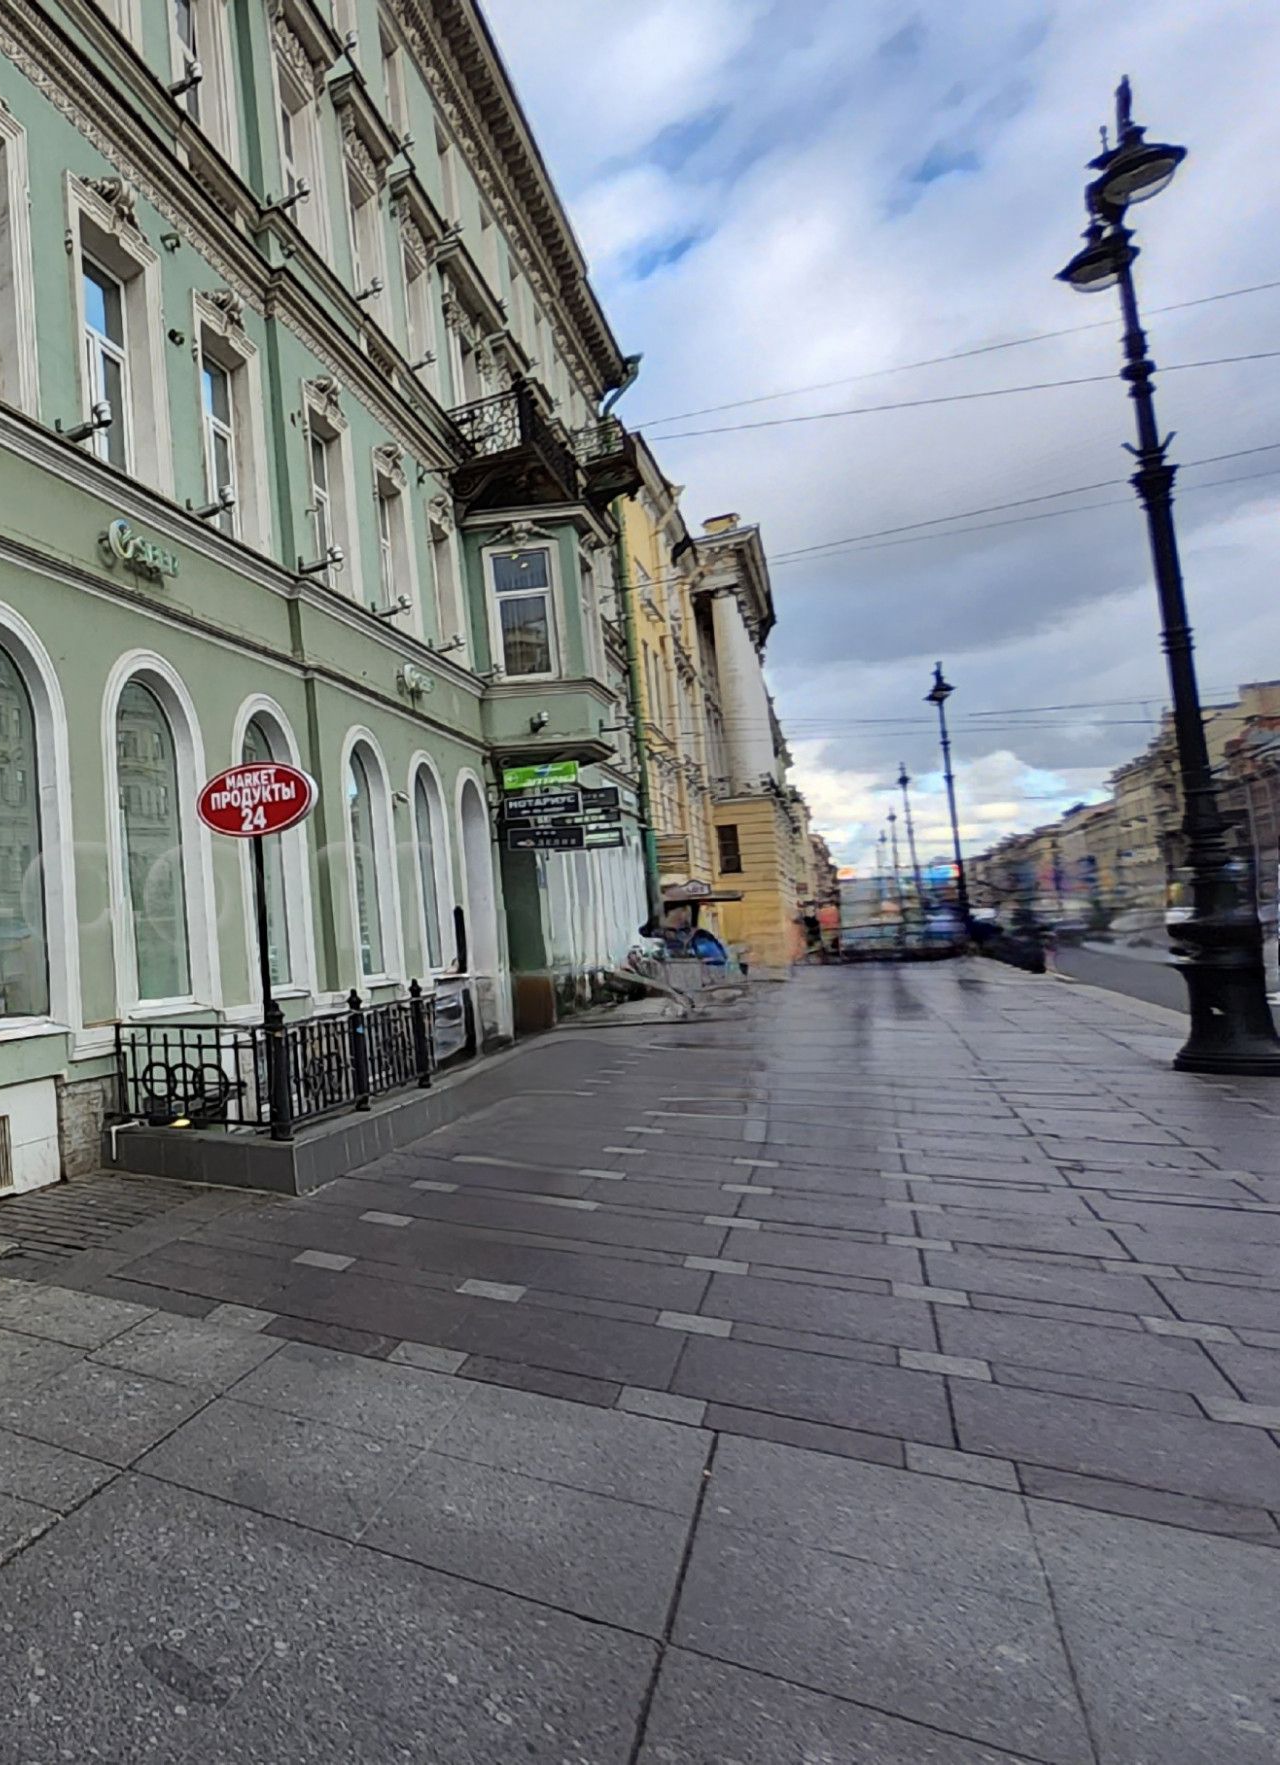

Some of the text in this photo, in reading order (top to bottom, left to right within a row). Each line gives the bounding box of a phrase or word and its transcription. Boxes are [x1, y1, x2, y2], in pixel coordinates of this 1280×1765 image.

[226, 769, 276, 791] MARKET
[211, 781, 296, 811] ПРОДУКТЫ
[241, 806, 267, 831] 24
